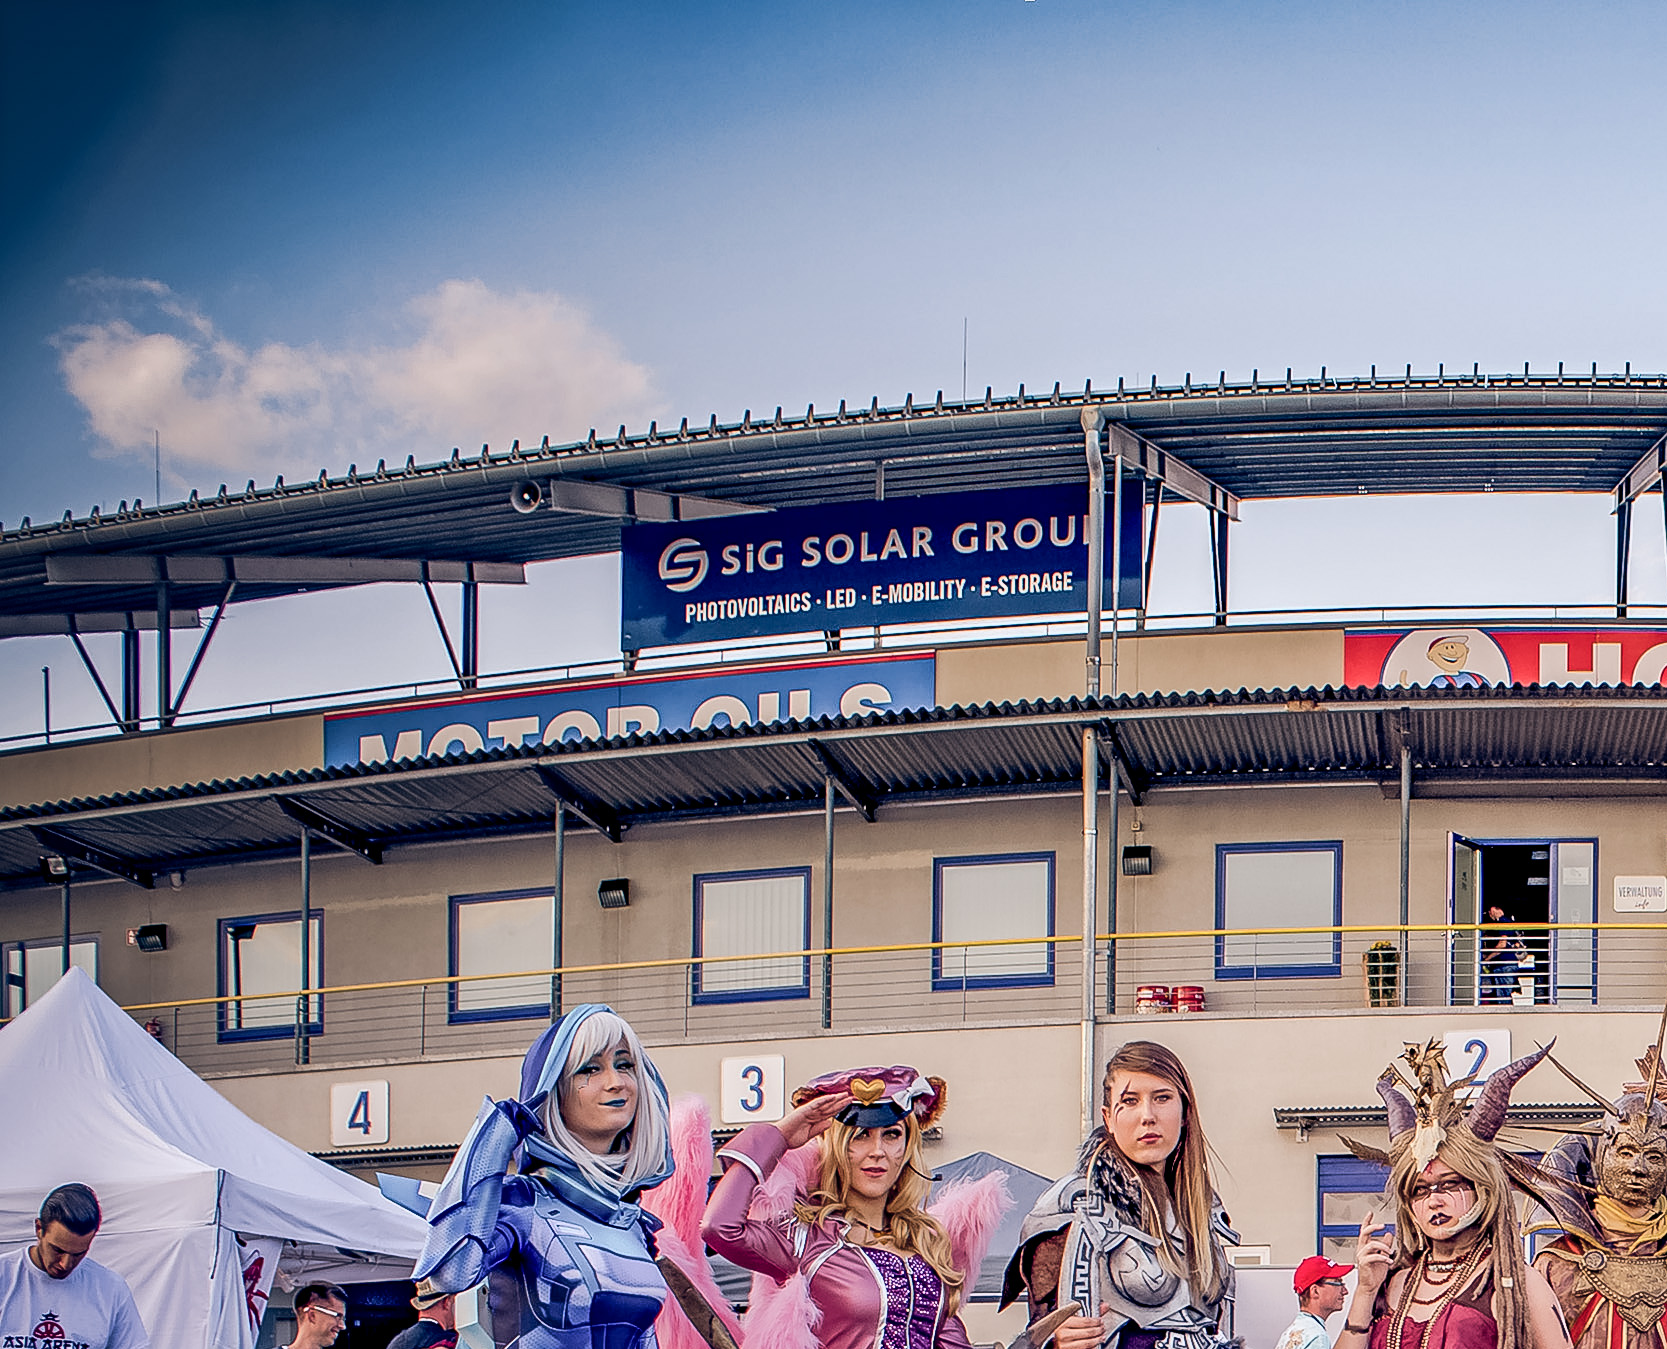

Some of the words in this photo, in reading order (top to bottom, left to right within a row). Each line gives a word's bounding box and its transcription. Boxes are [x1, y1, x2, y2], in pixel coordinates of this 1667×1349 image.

[801, 526, 935, 568] SOLAR
[685, 592, 812, 624] PHOTOVOLTAICS
[826, 588, 857, 609] LED
[872, 578, 966, 606] E-MOBILITY
[981, 571, 1074, 597] E-STORAGE
[1618, 886, 1664, 899] VERWALTUNG
[1464, 1039, 1490, 1087] 2
[742, 1066, 765, 1111] 3
[348, 1090, 373, 1135] 4
[3, 1335, 38, 1349] ASIA
